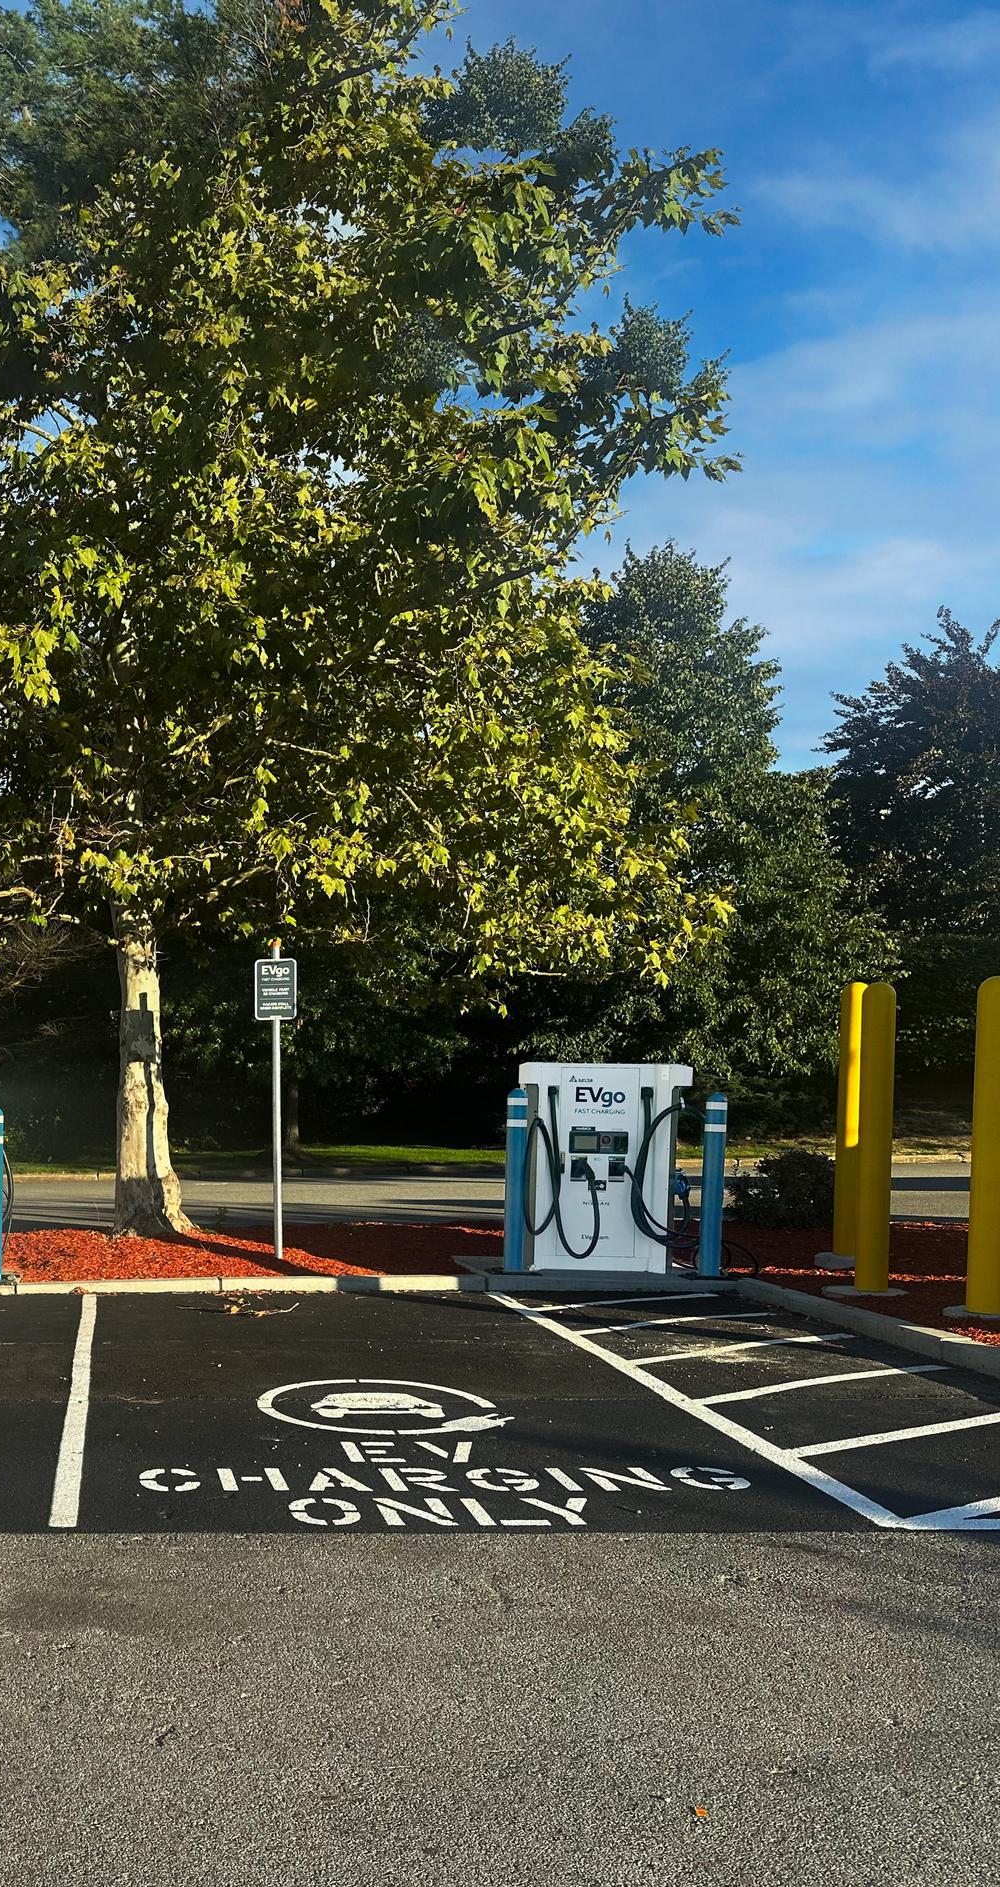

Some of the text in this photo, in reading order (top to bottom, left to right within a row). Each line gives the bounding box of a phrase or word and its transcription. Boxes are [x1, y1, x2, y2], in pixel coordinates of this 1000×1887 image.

[261, 965, 290, 977] EVgo
[575, 1086, 626, 1107] EVgo
[340, 1441, 473, 1464] EV
[138, 1466, 752, 1493] CHARGING
[287, 1498, 589, 1527] ONLY
